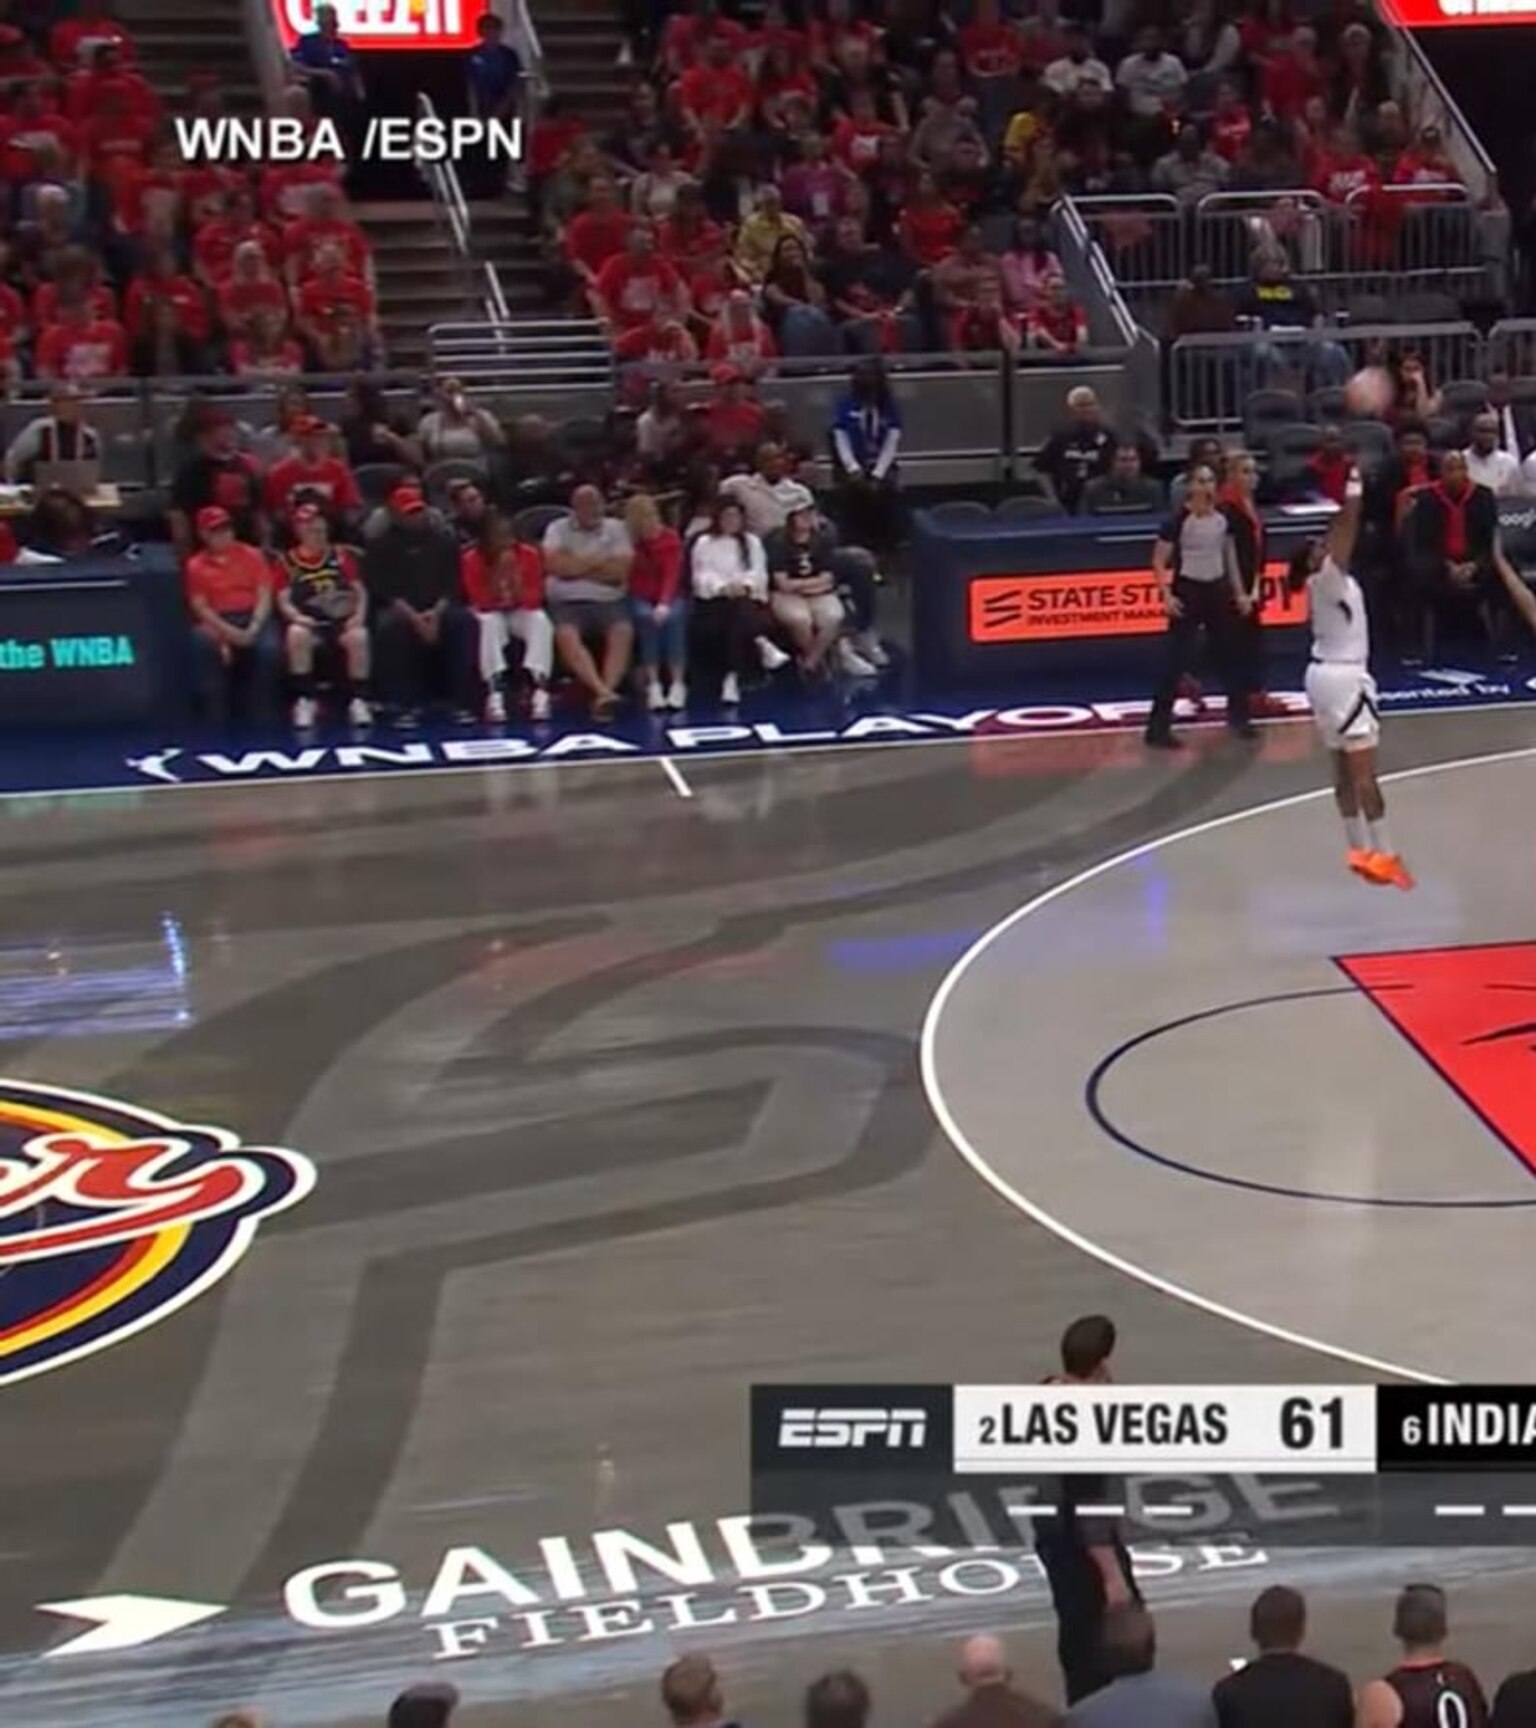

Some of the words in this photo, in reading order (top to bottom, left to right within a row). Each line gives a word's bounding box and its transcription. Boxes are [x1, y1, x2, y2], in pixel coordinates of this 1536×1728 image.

[1027, 585, 1116, 610] STATE
[1026, 611, 1121, 627] INVESTMENT
[51, 636, 135, 668] WNBA
[198, 732, 640, 774] WNBA
[422, 1530, 1270, 1660] FIELDHOSE
